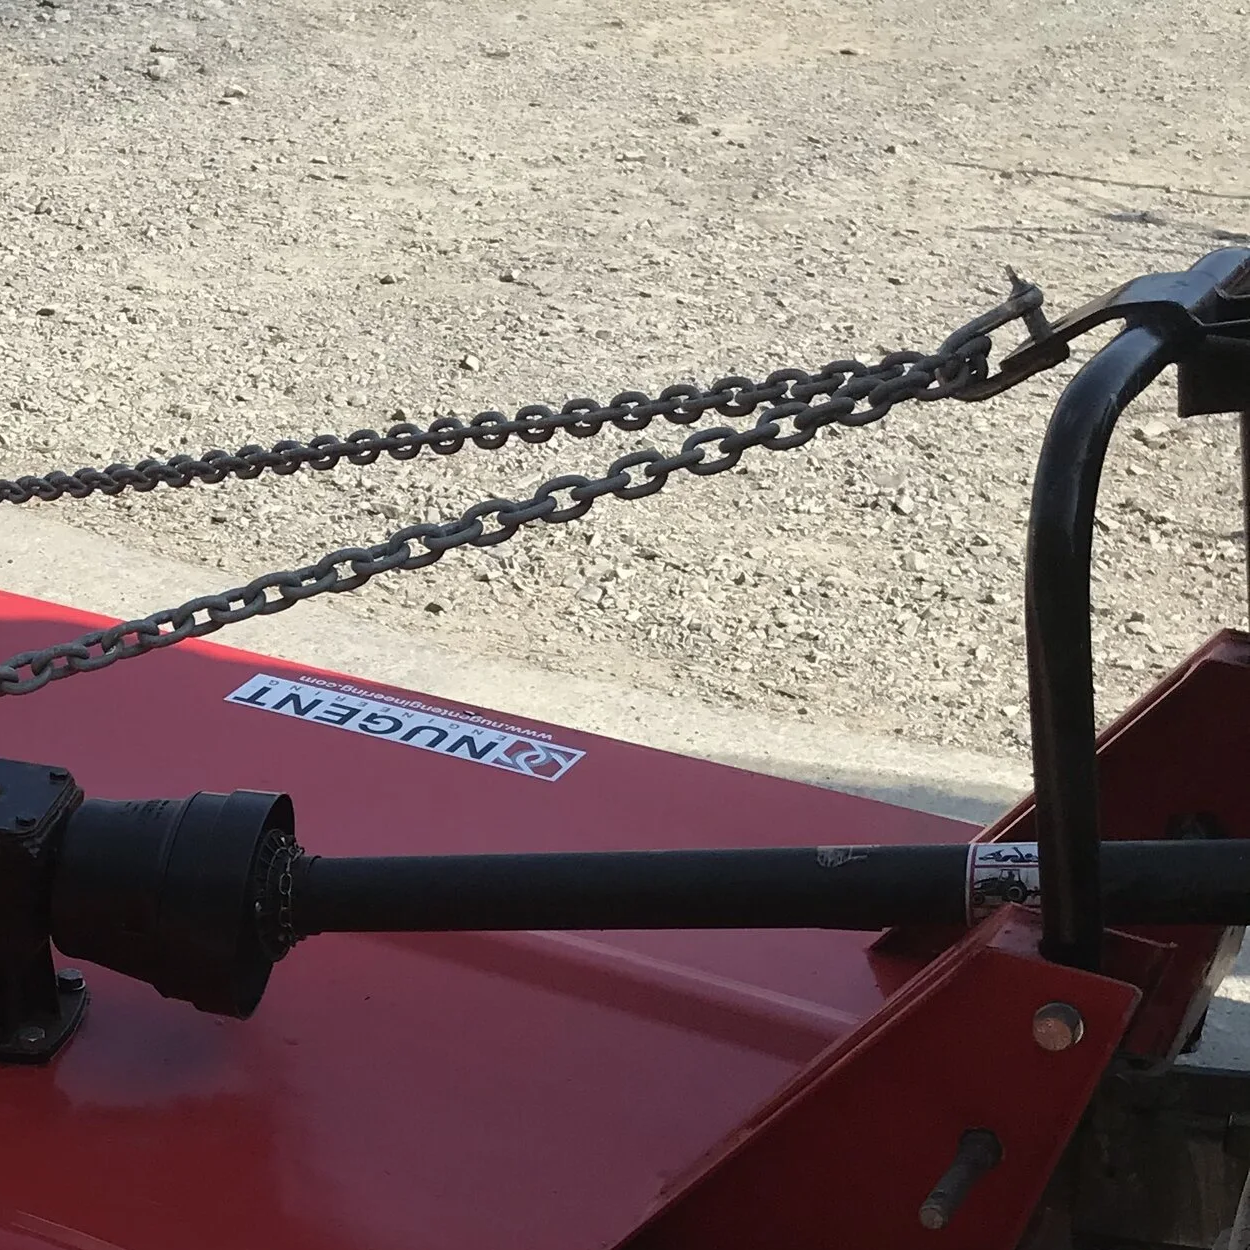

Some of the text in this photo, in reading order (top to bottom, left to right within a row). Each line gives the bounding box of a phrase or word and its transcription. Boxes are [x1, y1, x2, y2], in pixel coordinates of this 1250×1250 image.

[233, 686, 499, 760] NUGENT
[269, 679, 507, 742] ENGINEERING
[299, 675, 553, 741] www.nugentengineering.com
